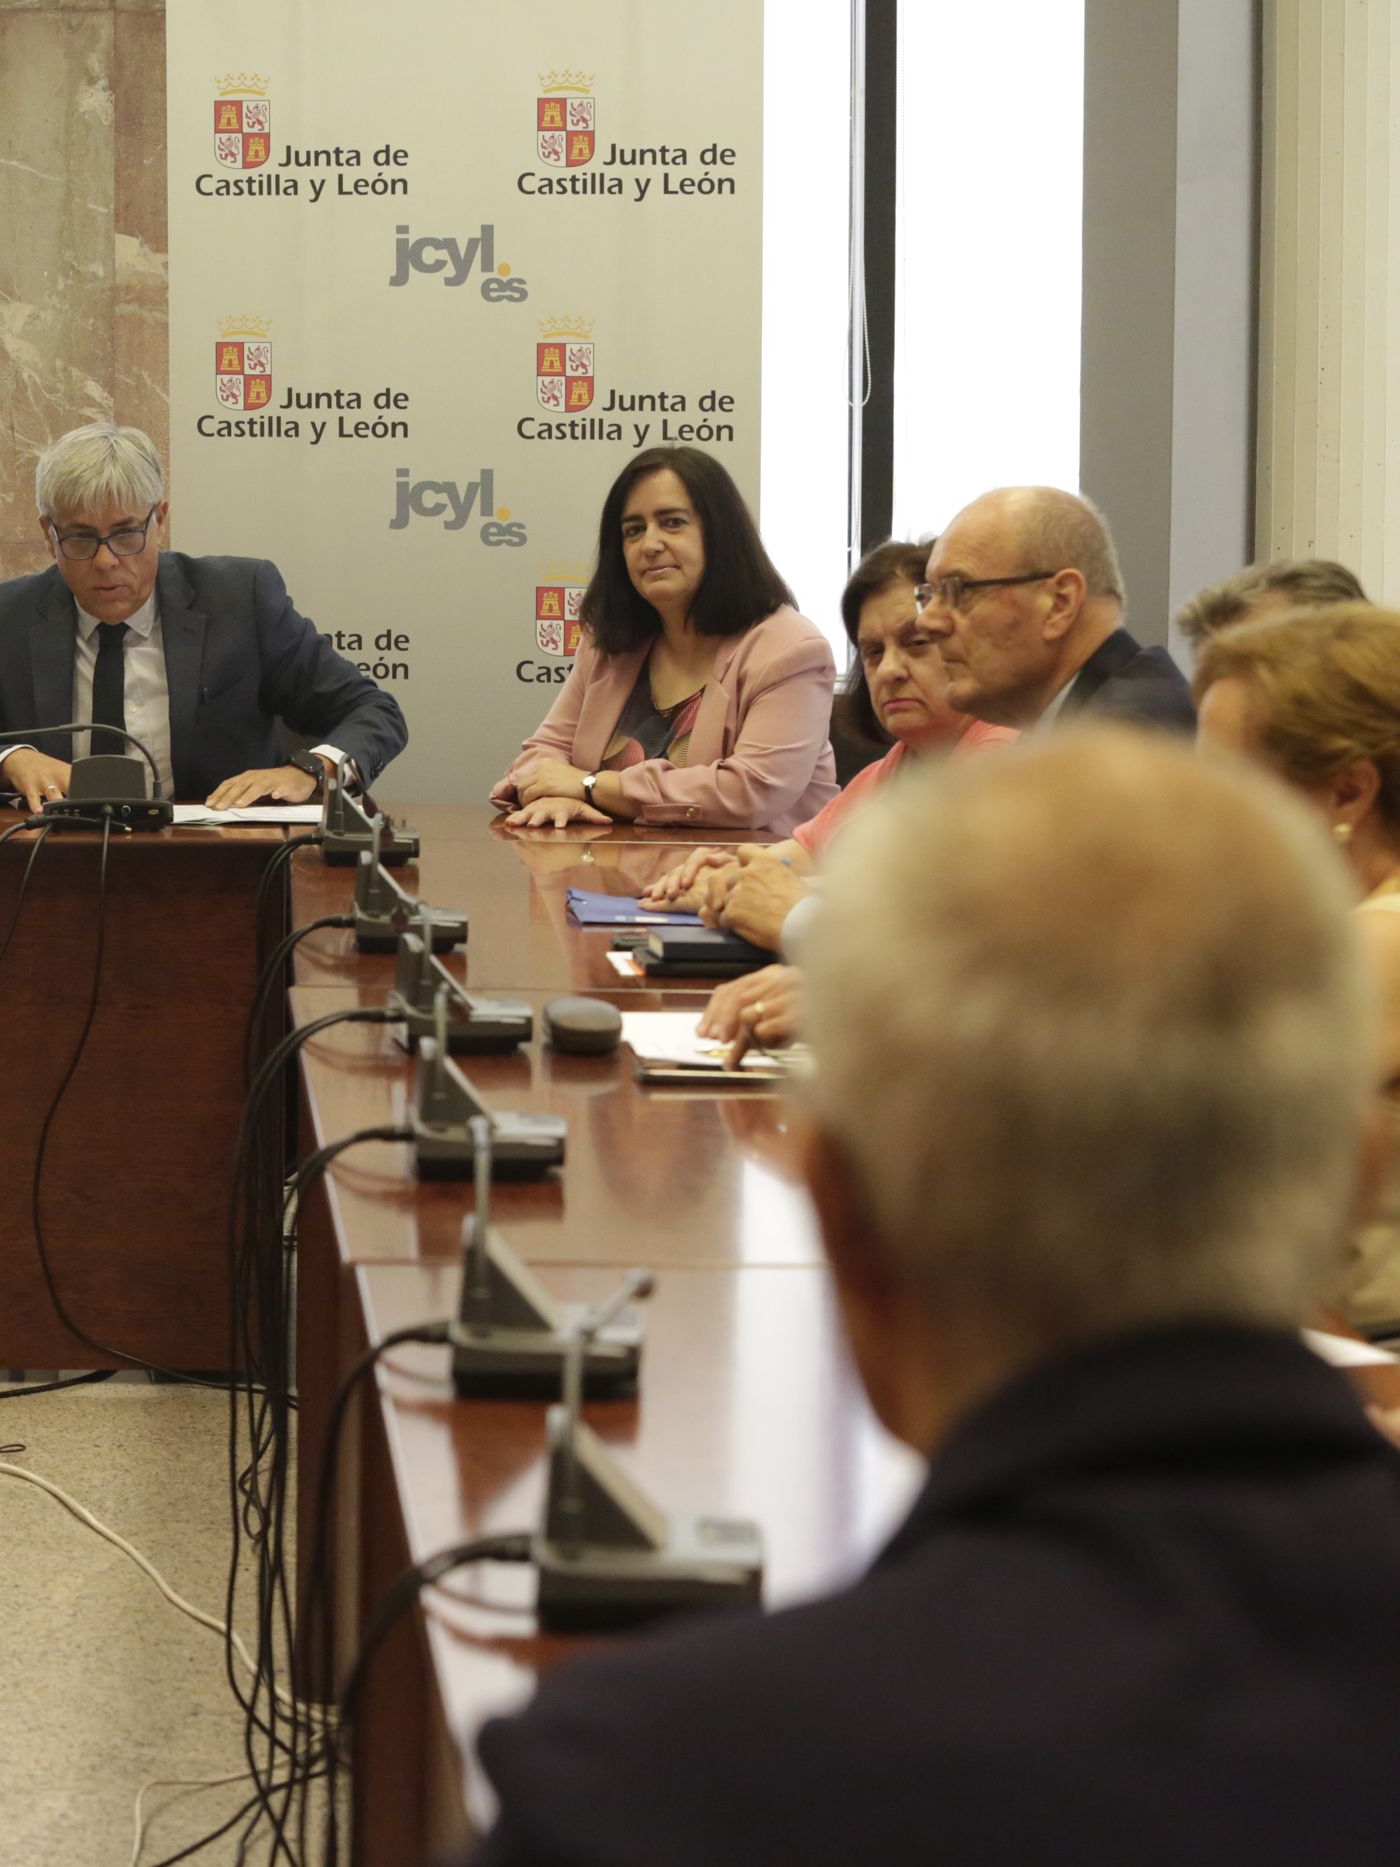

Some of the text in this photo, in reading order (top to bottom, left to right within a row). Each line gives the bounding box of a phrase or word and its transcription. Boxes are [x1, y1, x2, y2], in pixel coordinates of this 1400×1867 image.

[277, 143, 409, 168] Junta de
[602, 142, 737, 166] Junta de
[195, 171, 408, 204] Castilla y León
[517, 171, 736, 203] Castilla y León
[279, 386, 410, 410] Junta de
[601, 388, 735, 413] Junta de
[196, 414, 409, 446] Castilla y León
[516, 416, 734, 449] Castilla y León
[374, 628, 410, 652] de
[356, 656, 409, 680] eón
